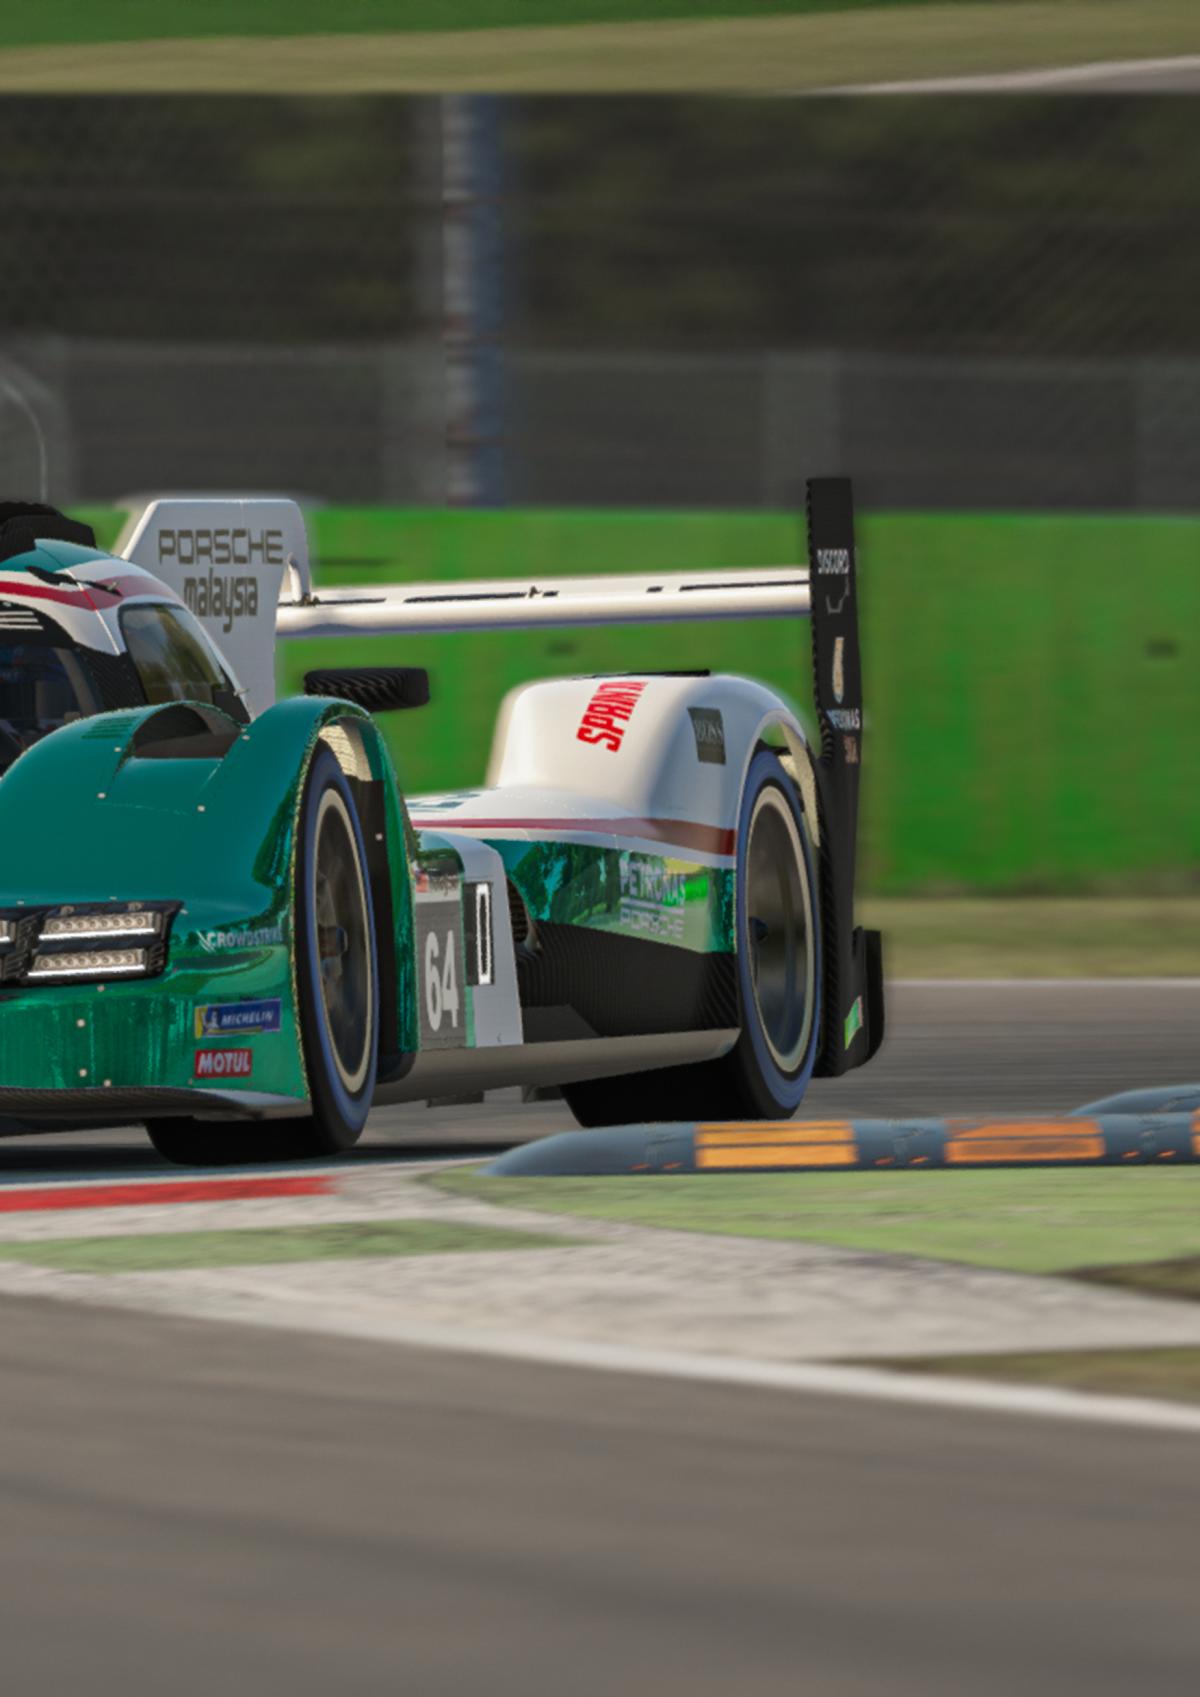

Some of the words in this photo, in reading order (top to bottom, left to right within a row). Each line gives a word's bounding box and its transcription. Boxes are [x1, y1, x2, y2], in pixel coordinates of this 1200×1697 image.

[159, 529, 284, 564] PORSCHE
[184, 567, 259, 633] malaysia
[425, 930, 460, 1032] 64
[220, 1010, 275, 1026] MICHELIN
[197, 1052, 250, 1074] MOTUL
